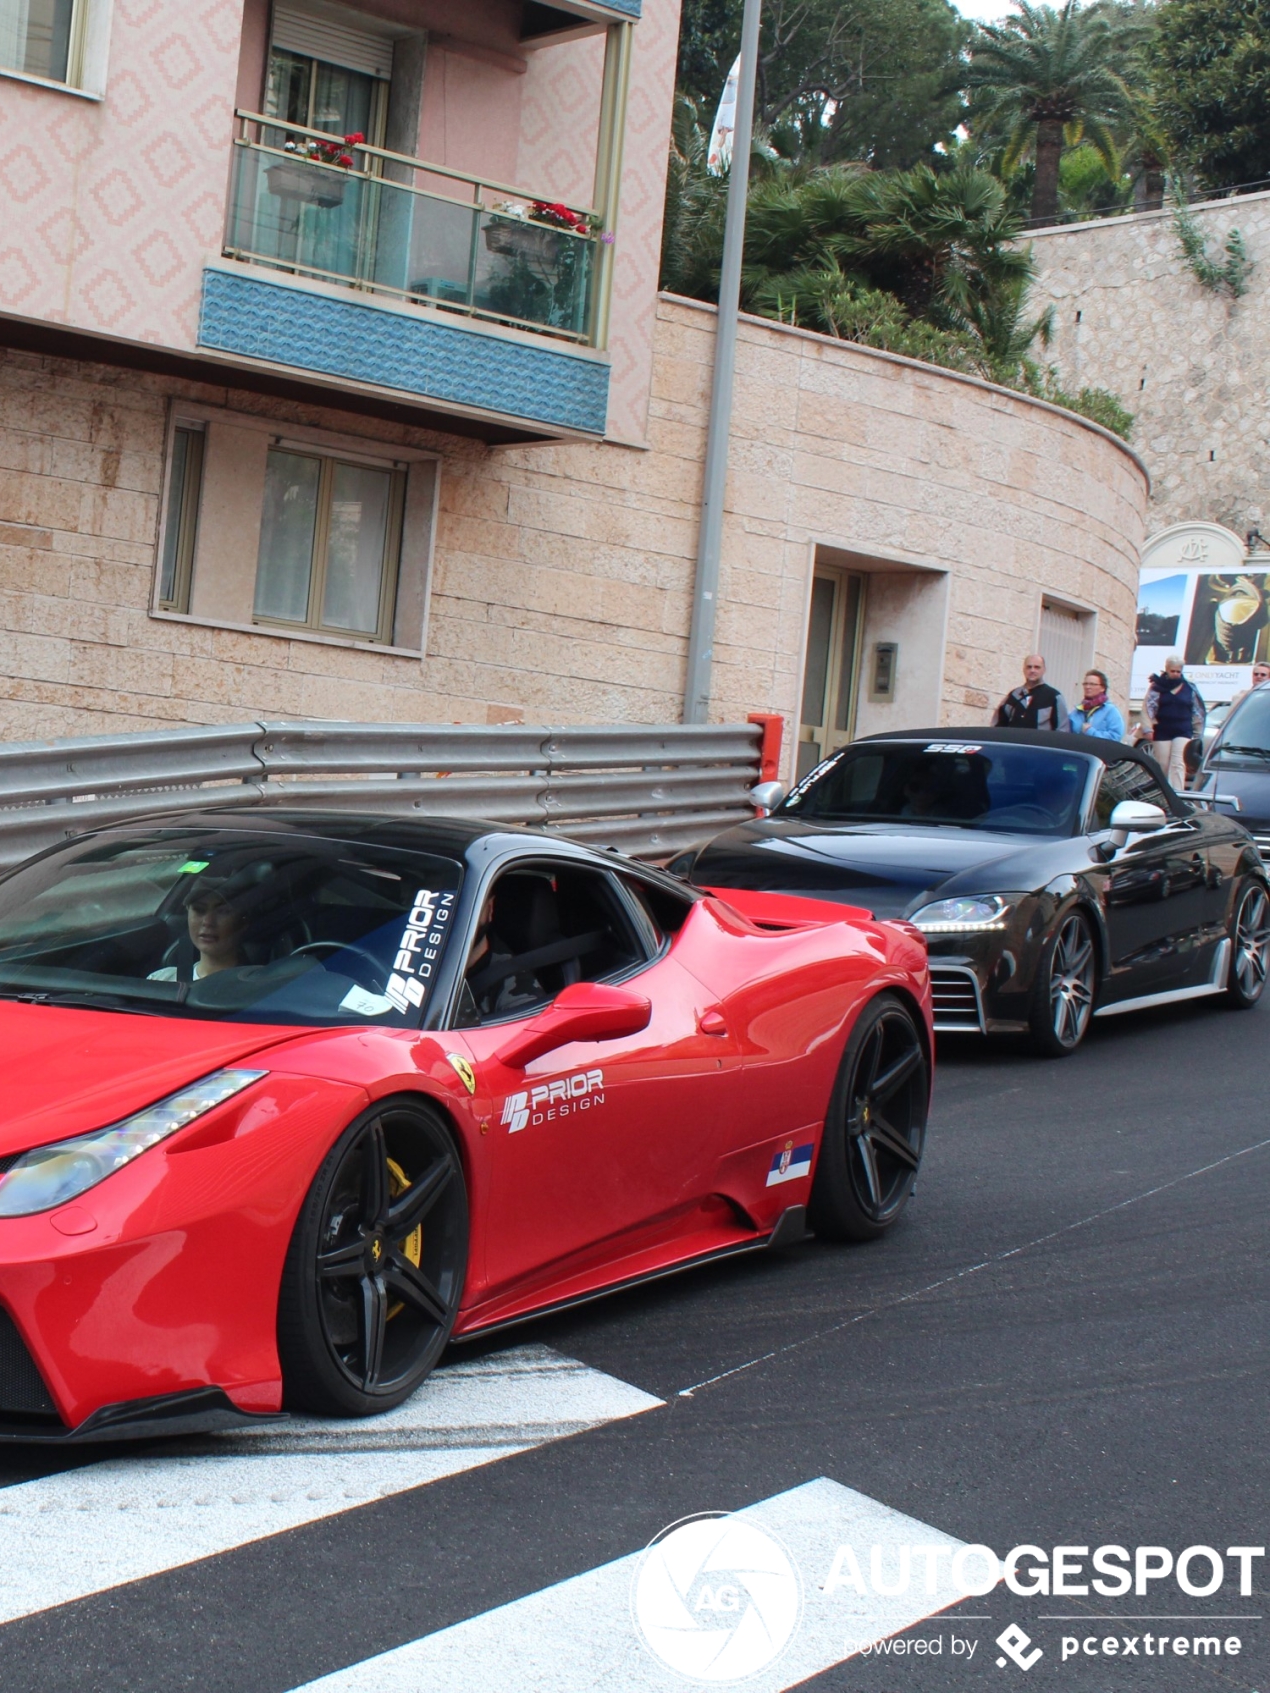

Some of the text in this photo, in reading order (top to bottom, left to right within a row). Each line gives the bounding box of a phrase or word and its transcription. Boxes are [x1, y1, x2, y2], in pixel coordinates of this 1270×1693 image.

[393, 889, 440, 974] PRIOR
[418, 893, 455, 978] DESIGN
[531, 1068, 605, 1110] PRIOR
[532, 1093, 605, 1126] DESIGN
